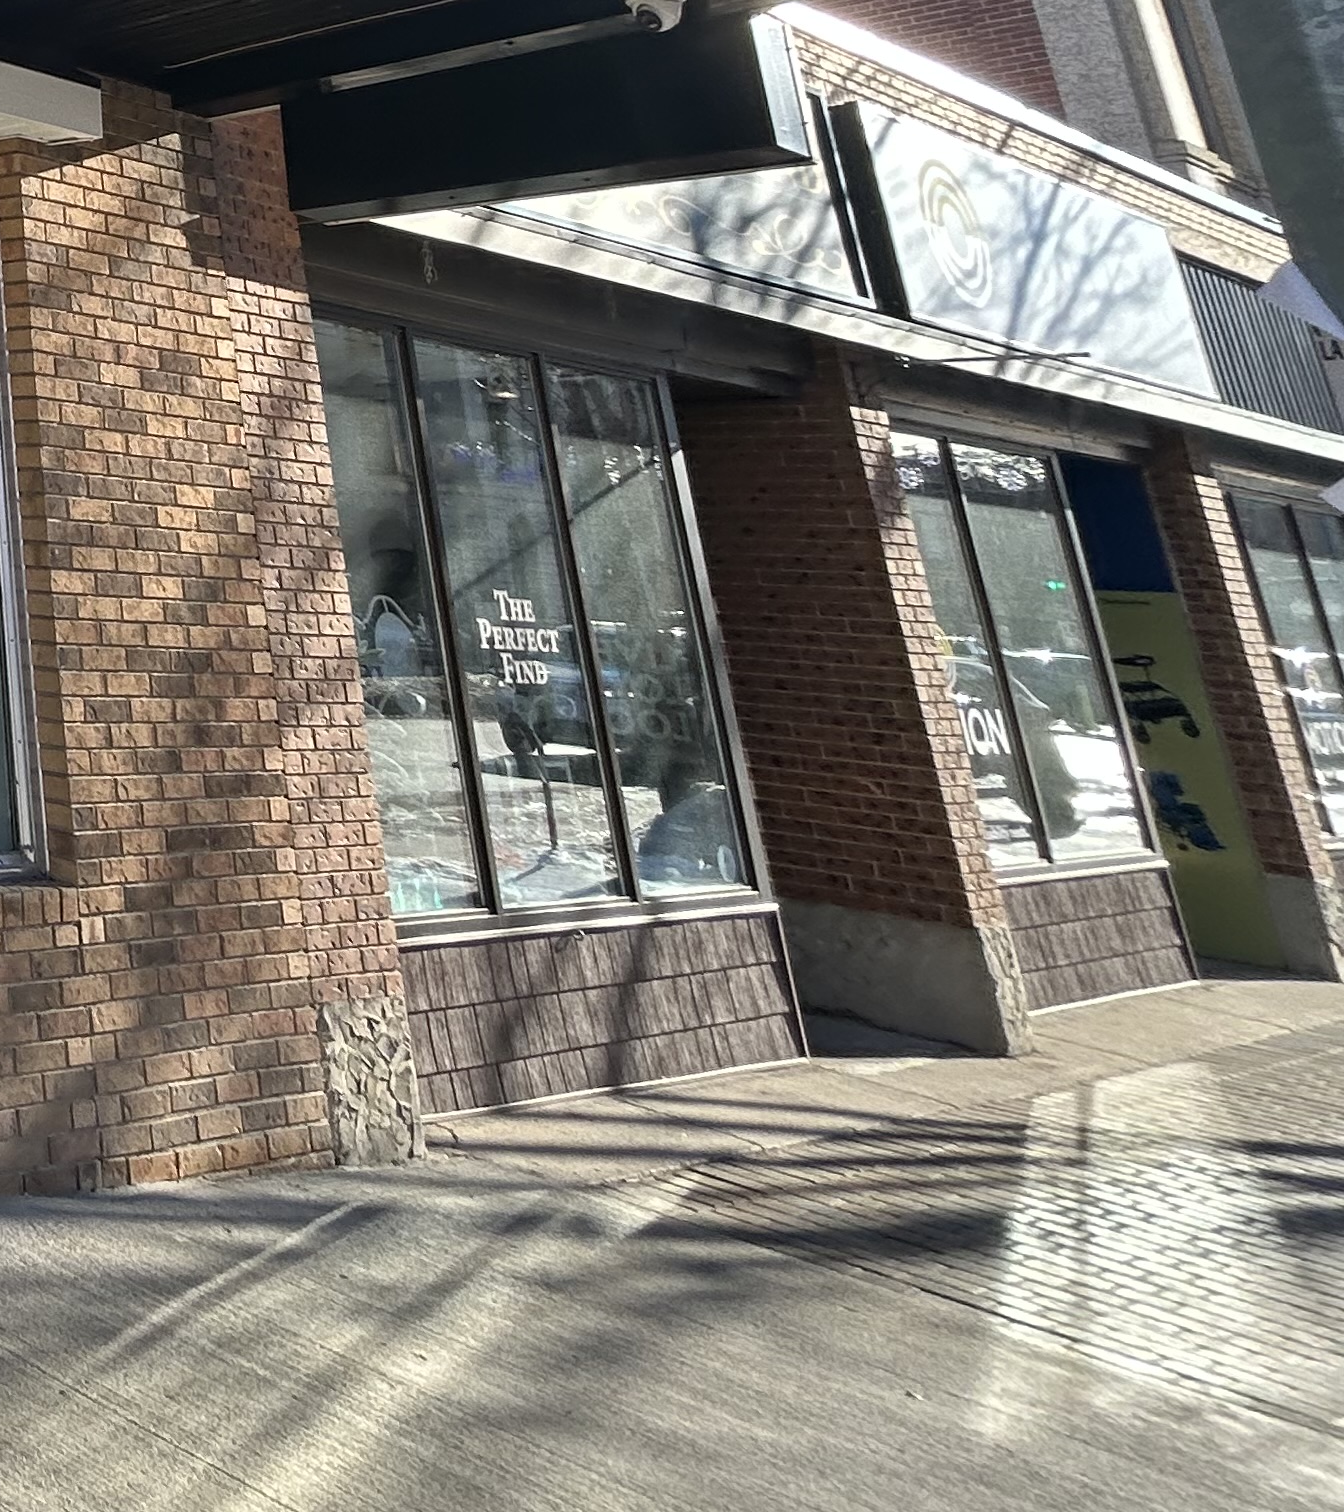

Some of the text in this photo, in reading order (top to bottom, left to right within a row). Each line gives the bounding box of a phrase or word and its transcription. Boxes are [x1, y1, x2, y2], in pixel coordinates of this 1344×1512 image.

[492, 587, 536, 622] THE
[475, 617, 561, 653] PERFECT
[498, 652, 549, 685] FIND
